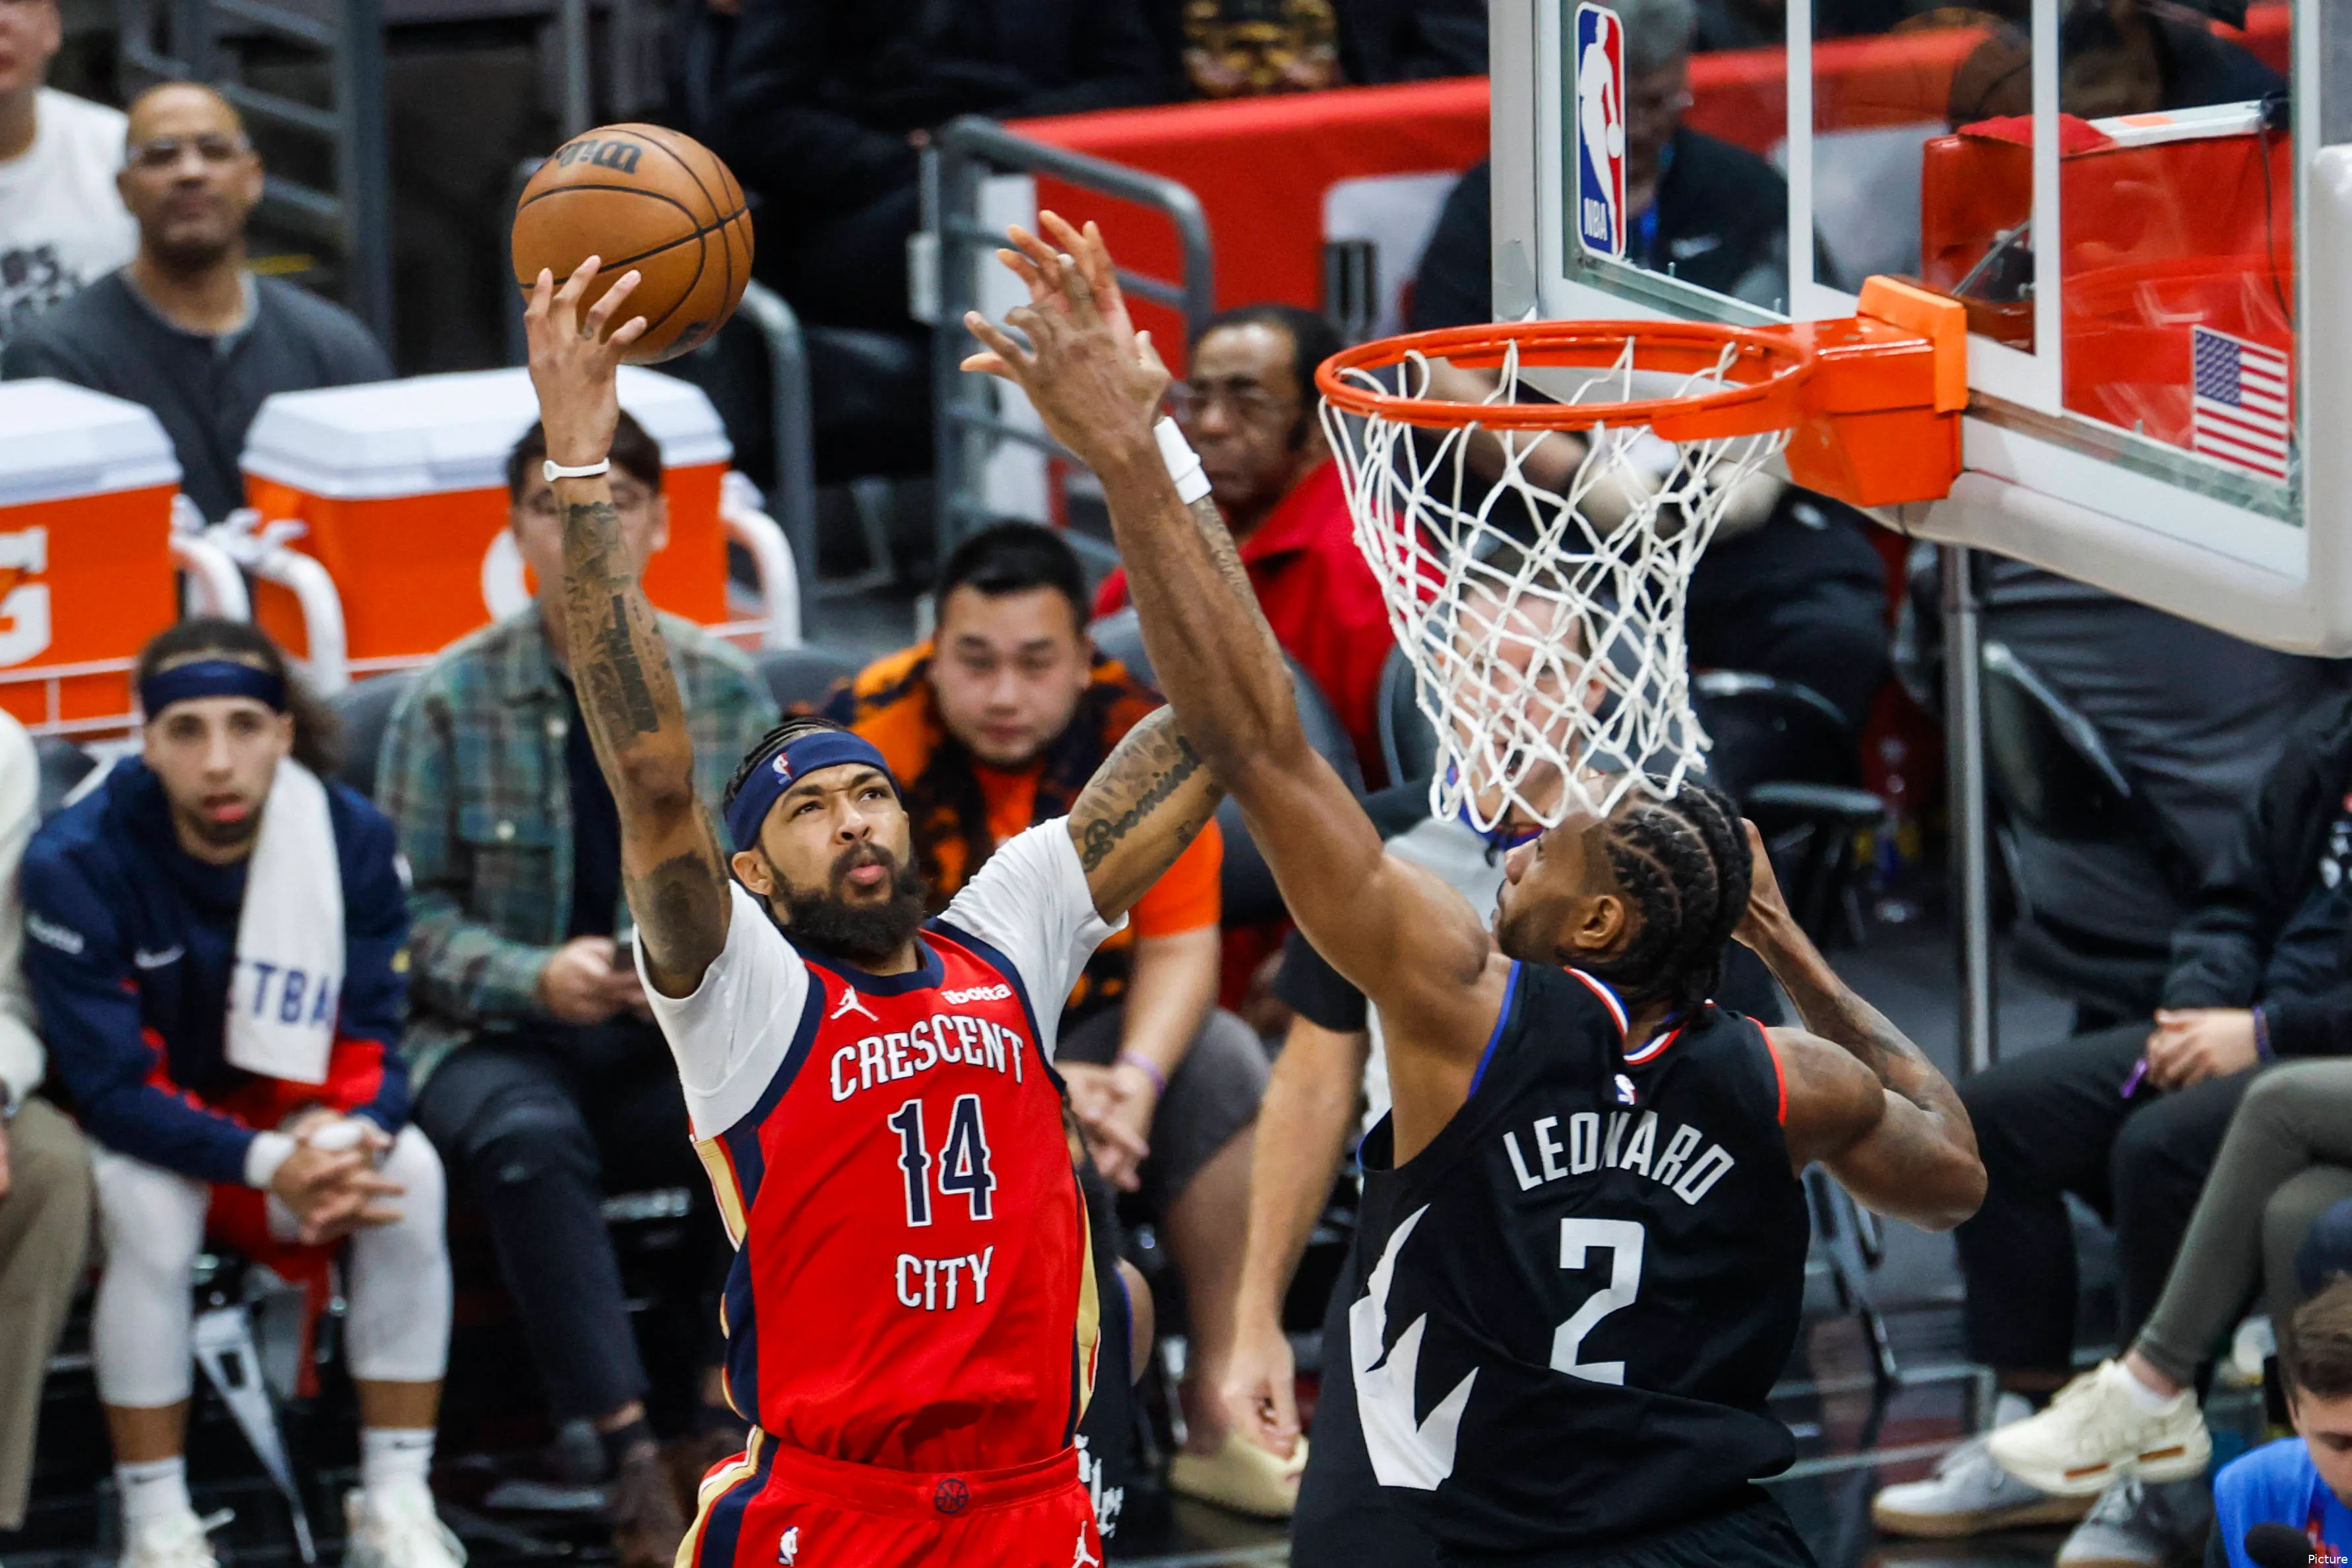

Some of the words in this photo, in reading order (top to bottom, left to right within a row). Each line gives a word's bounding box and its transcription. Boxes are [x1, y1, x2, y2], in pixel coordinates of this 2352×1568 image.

[1584, 197, 1608, 241] NBA
[941, 983, 1012, 1005] ibotta
[830, 1014, 1025, 1102] CRESCENT
[887, 1094, 997, 1228] 14
[895, 1245, 994, 1311] CITY
[1550, 1218, 1645, 1385] 2
